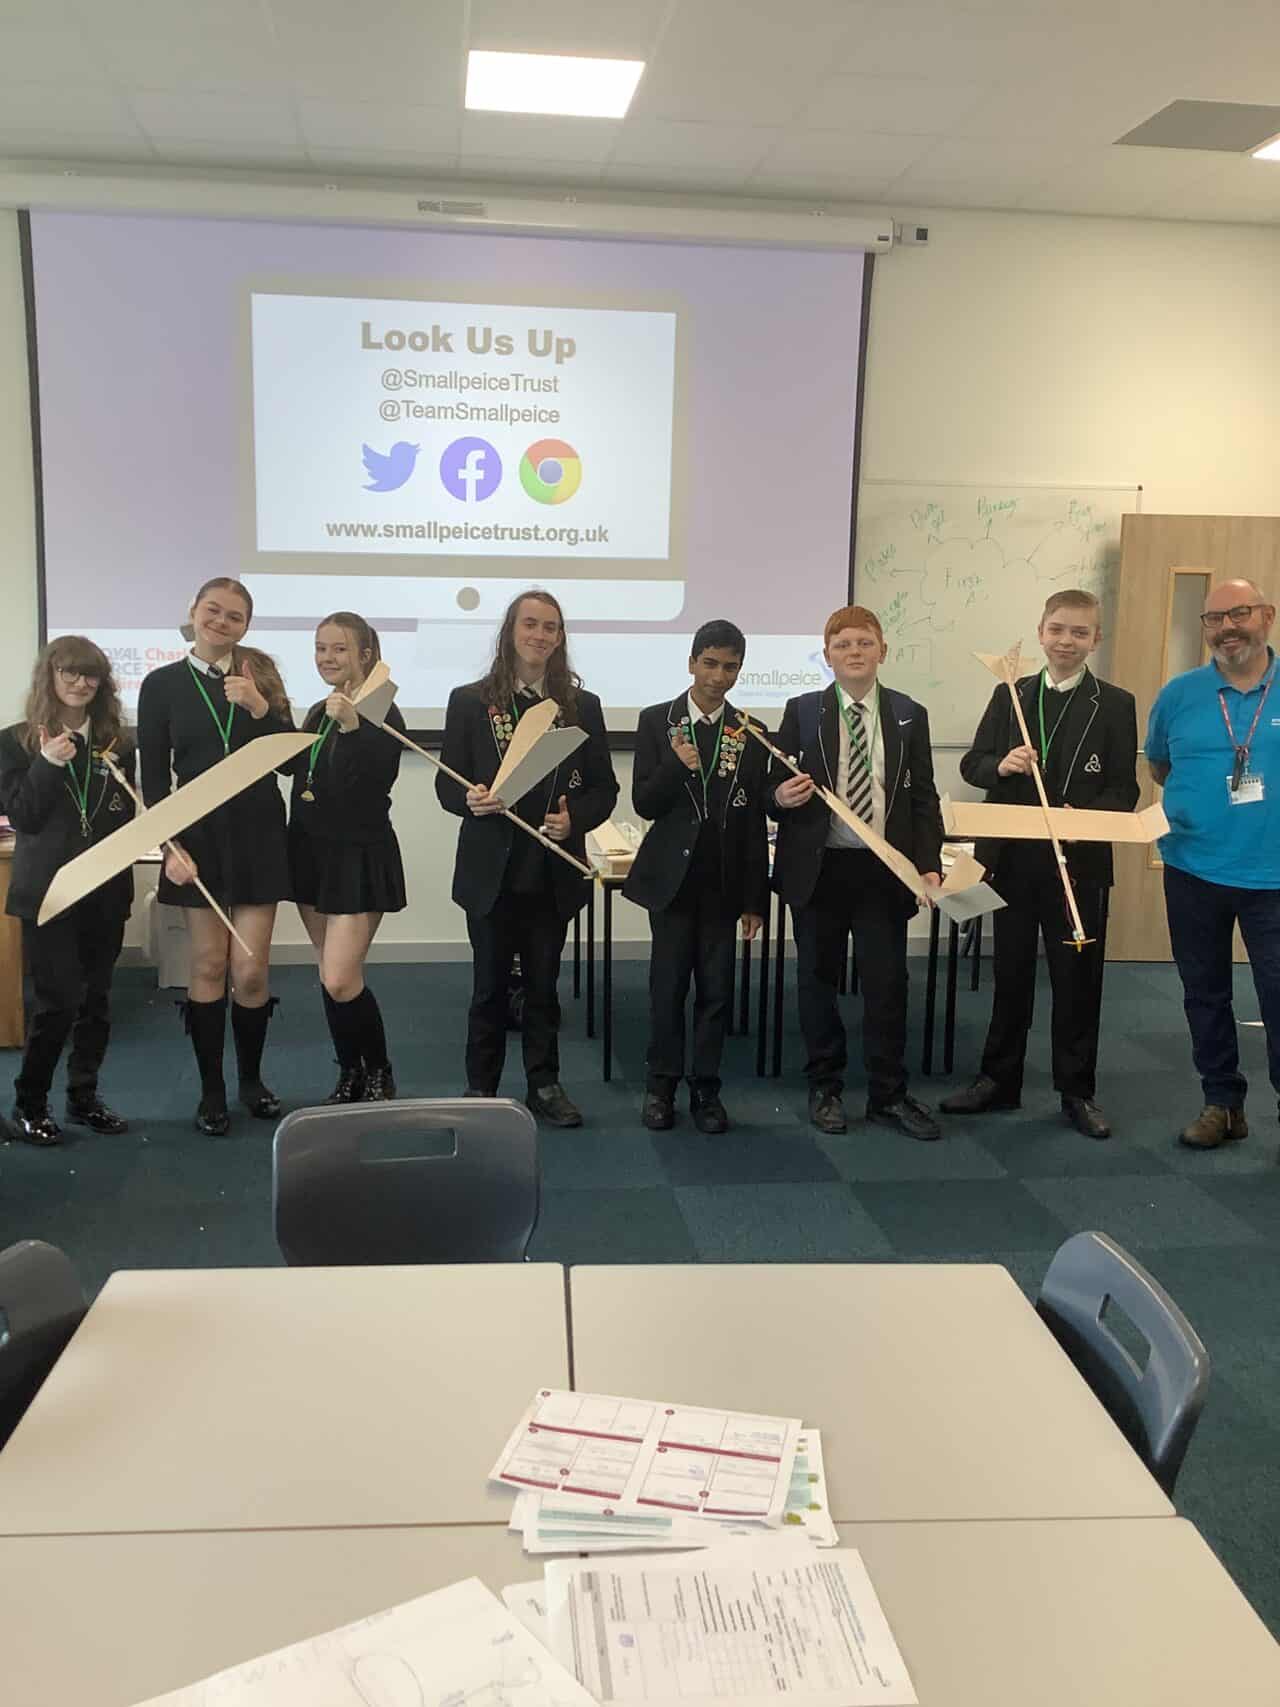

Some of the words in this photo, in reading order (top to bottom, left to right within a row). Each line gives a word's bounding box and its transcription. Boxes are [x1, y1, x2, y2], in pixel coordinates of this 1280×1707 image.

[361, 322, 454, 352] Look
[467, 327, 514, 356] Us
[527, 329, 577, 364] Up
[381, 368, 560, 393] @SmallpeiceTrust
[378, 399, 561, 426] @TeamSmallpeice
[326, 521, 610, 546] www.smallpeicetrust.org.uk
[739, 669, 822, 688] smallpeice
